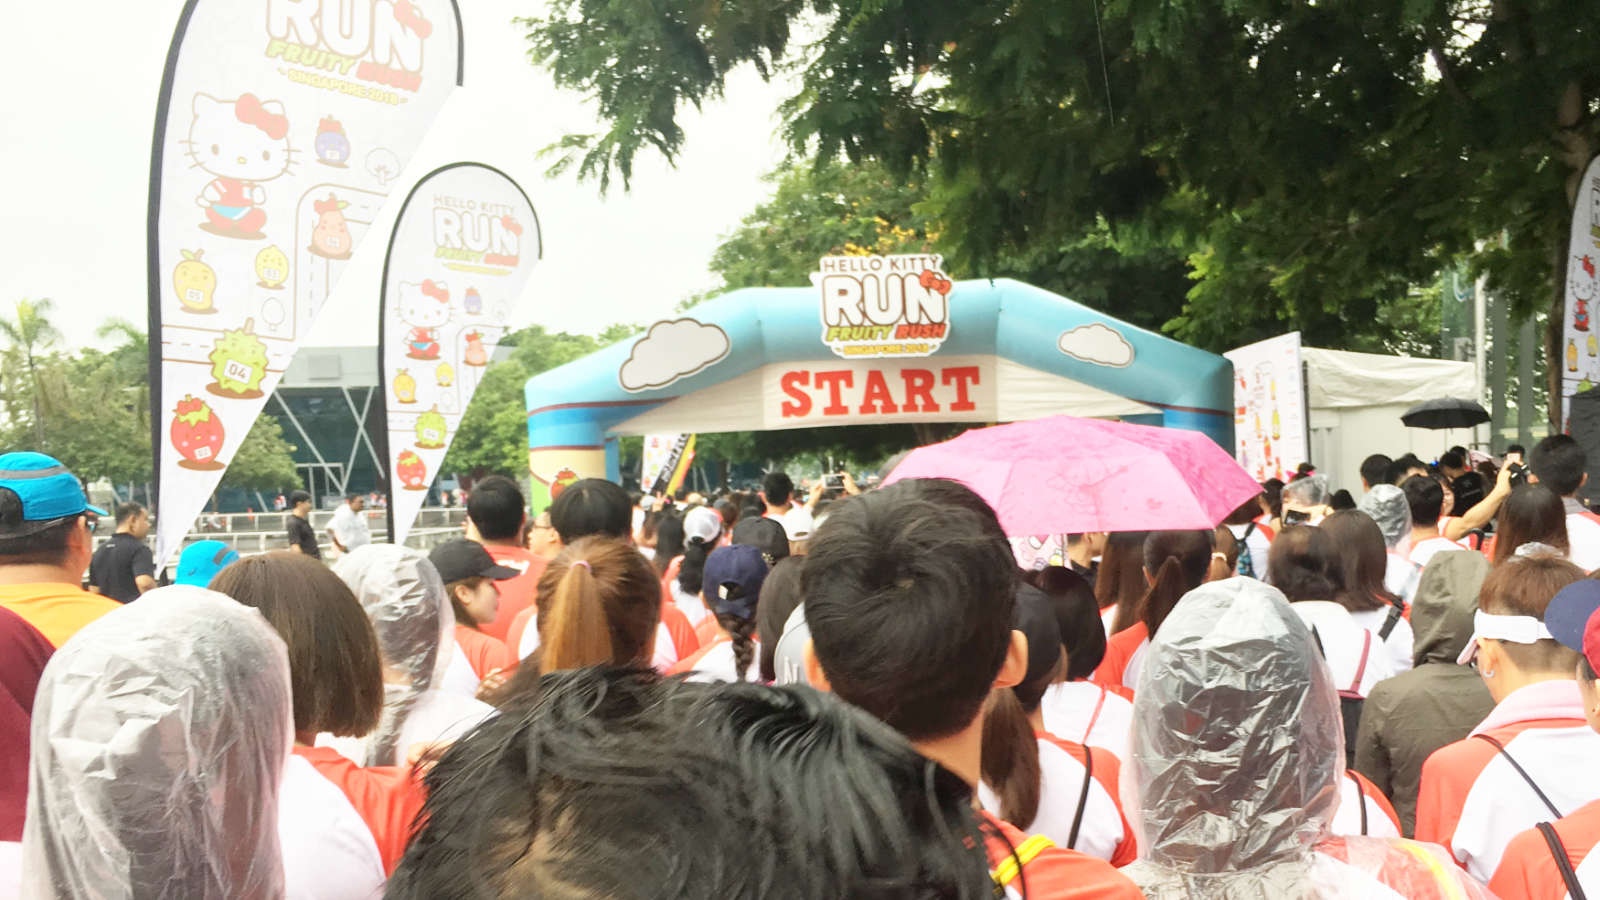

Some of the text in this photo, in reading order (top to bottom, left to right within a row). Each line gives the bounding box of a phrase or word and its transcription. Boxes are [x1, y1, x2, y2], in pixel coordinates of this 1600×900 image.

[265, 0, 424, 73] RUN
[265, 38, 358, 75] FRUITY
[433, 207, 520, 255] RUN
[824, 256, 939, 272] HELLO KITTY
[823, 274, 946, 325] RUN
[826, 323, 947, 341] FRUITY RUSH
[229, 362, 247, 379] 04
[781, 366, 980, 418] START
